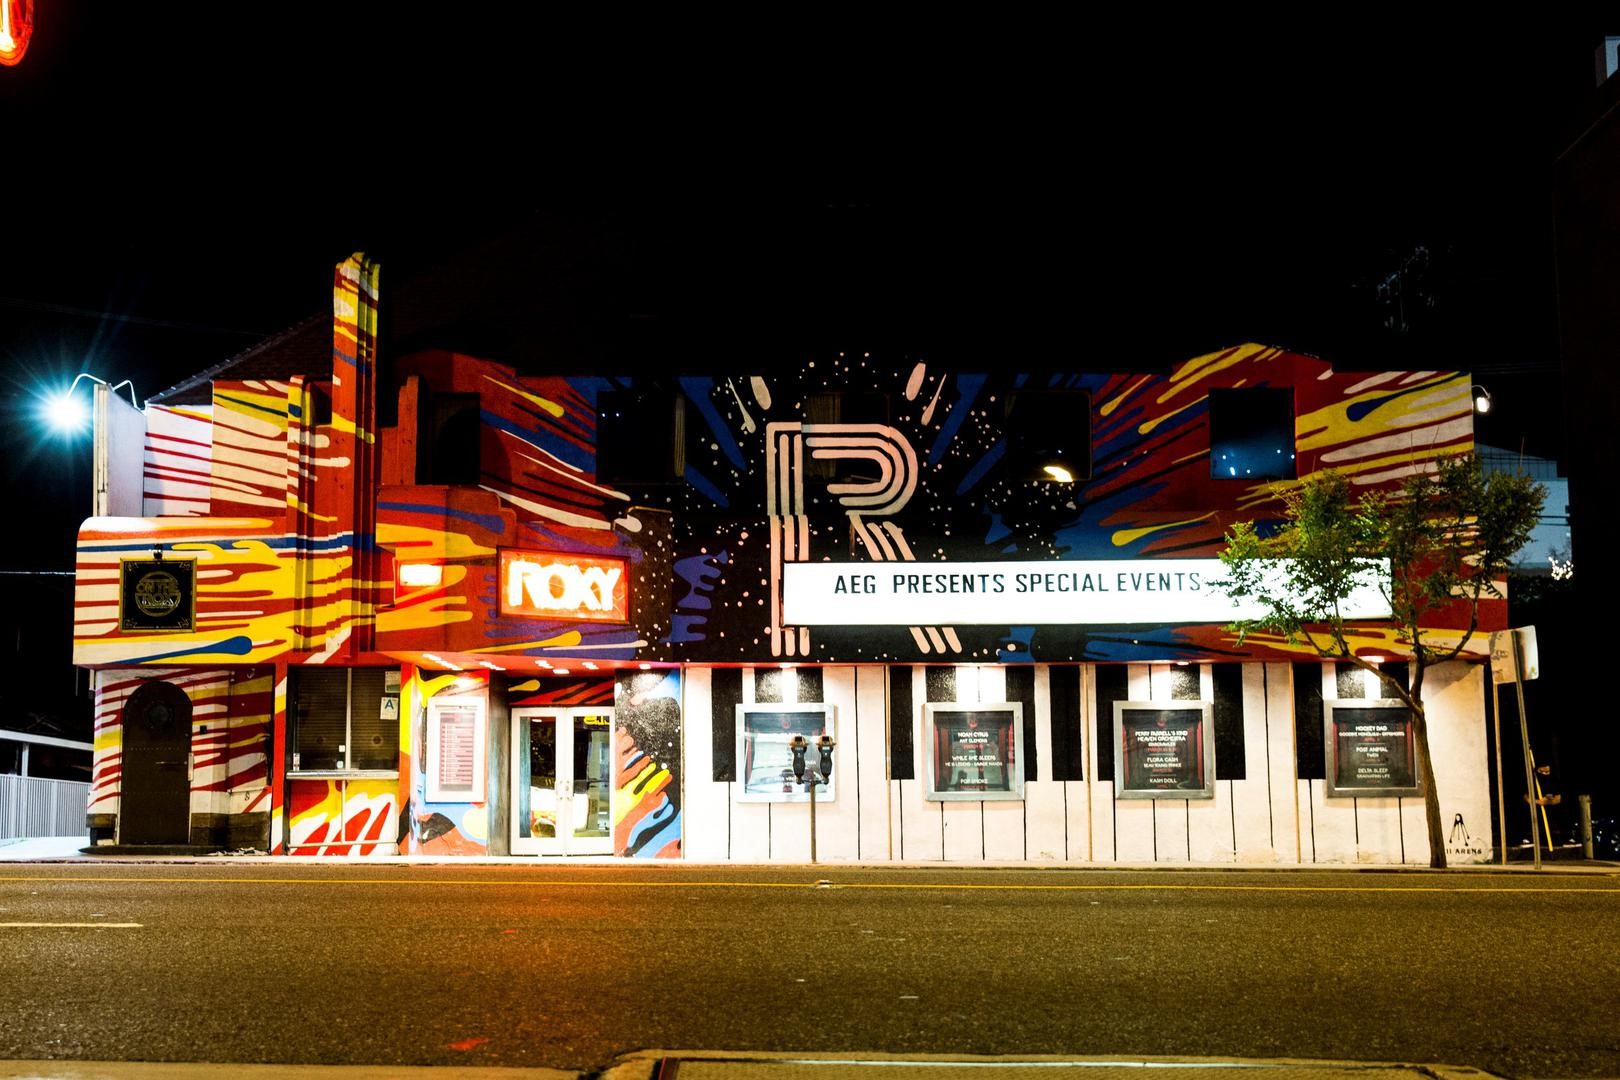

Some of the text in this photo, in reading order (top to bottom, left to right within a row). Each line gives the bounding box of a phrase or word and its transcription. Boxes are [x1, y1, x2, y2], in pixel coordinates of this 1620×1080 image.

[507, 559, 622, 611] ROXY
[834, 571, 1201, 594] AEG PRESENTS SPECIAL EVENTS
[384, 698, 395, 710] A
